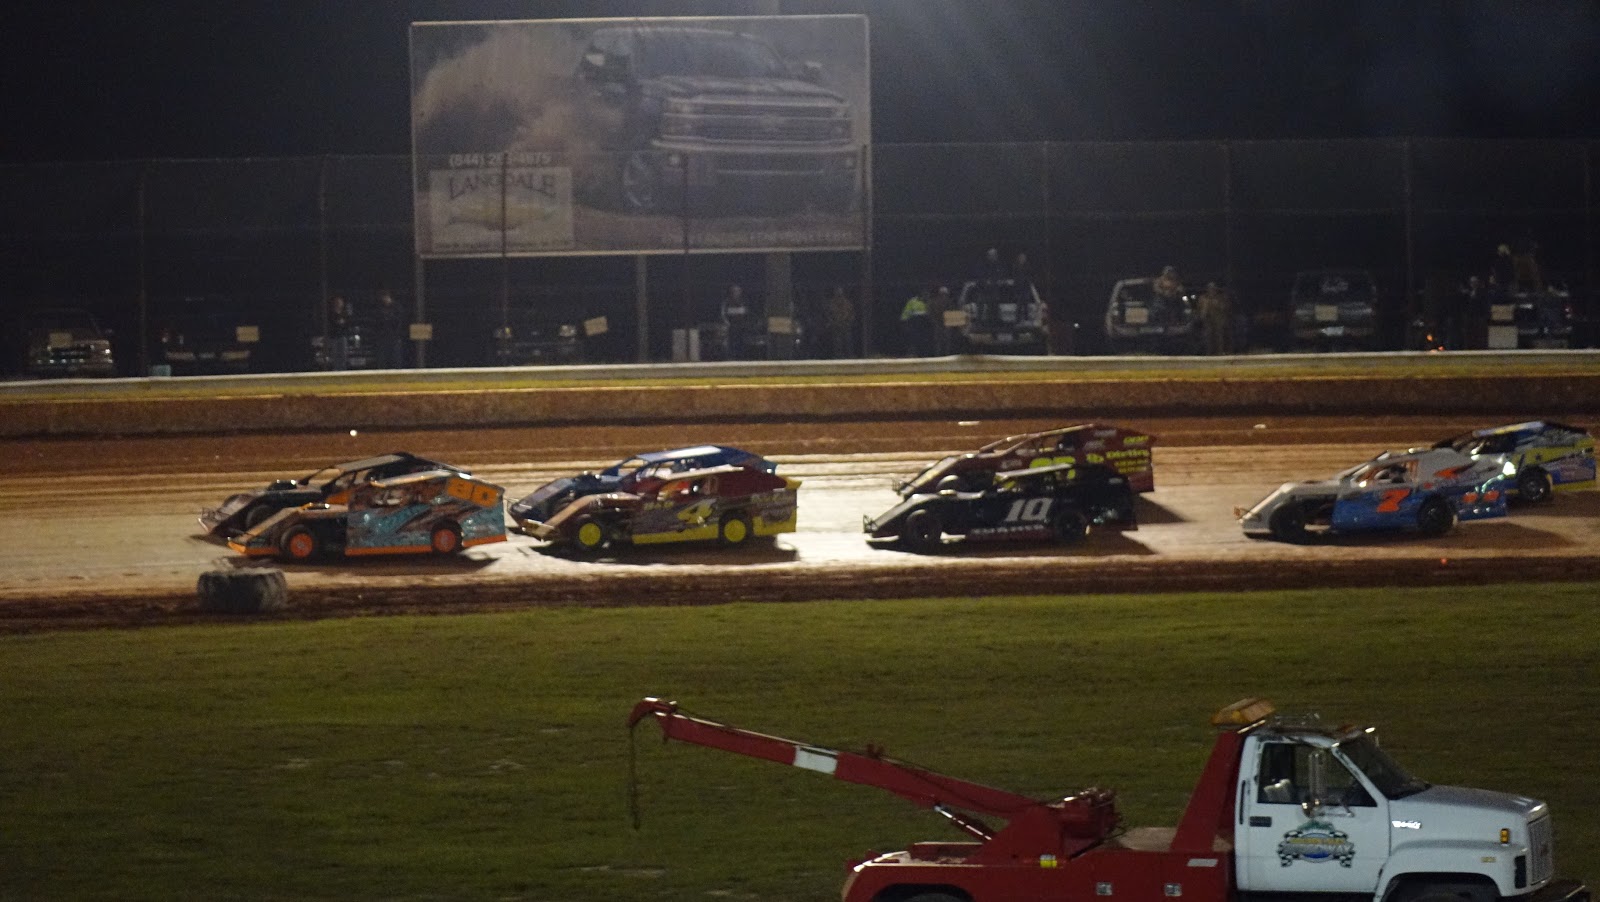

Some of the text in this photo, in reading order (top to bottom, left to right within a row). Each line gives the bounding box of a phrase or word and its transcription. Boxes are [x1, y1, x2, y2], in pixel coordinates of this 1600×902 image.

[448, 173, 557, 200] LANGDALE
[1004, 498, 1054, 522] 10
[1376, 488, 1411, 513] 7
